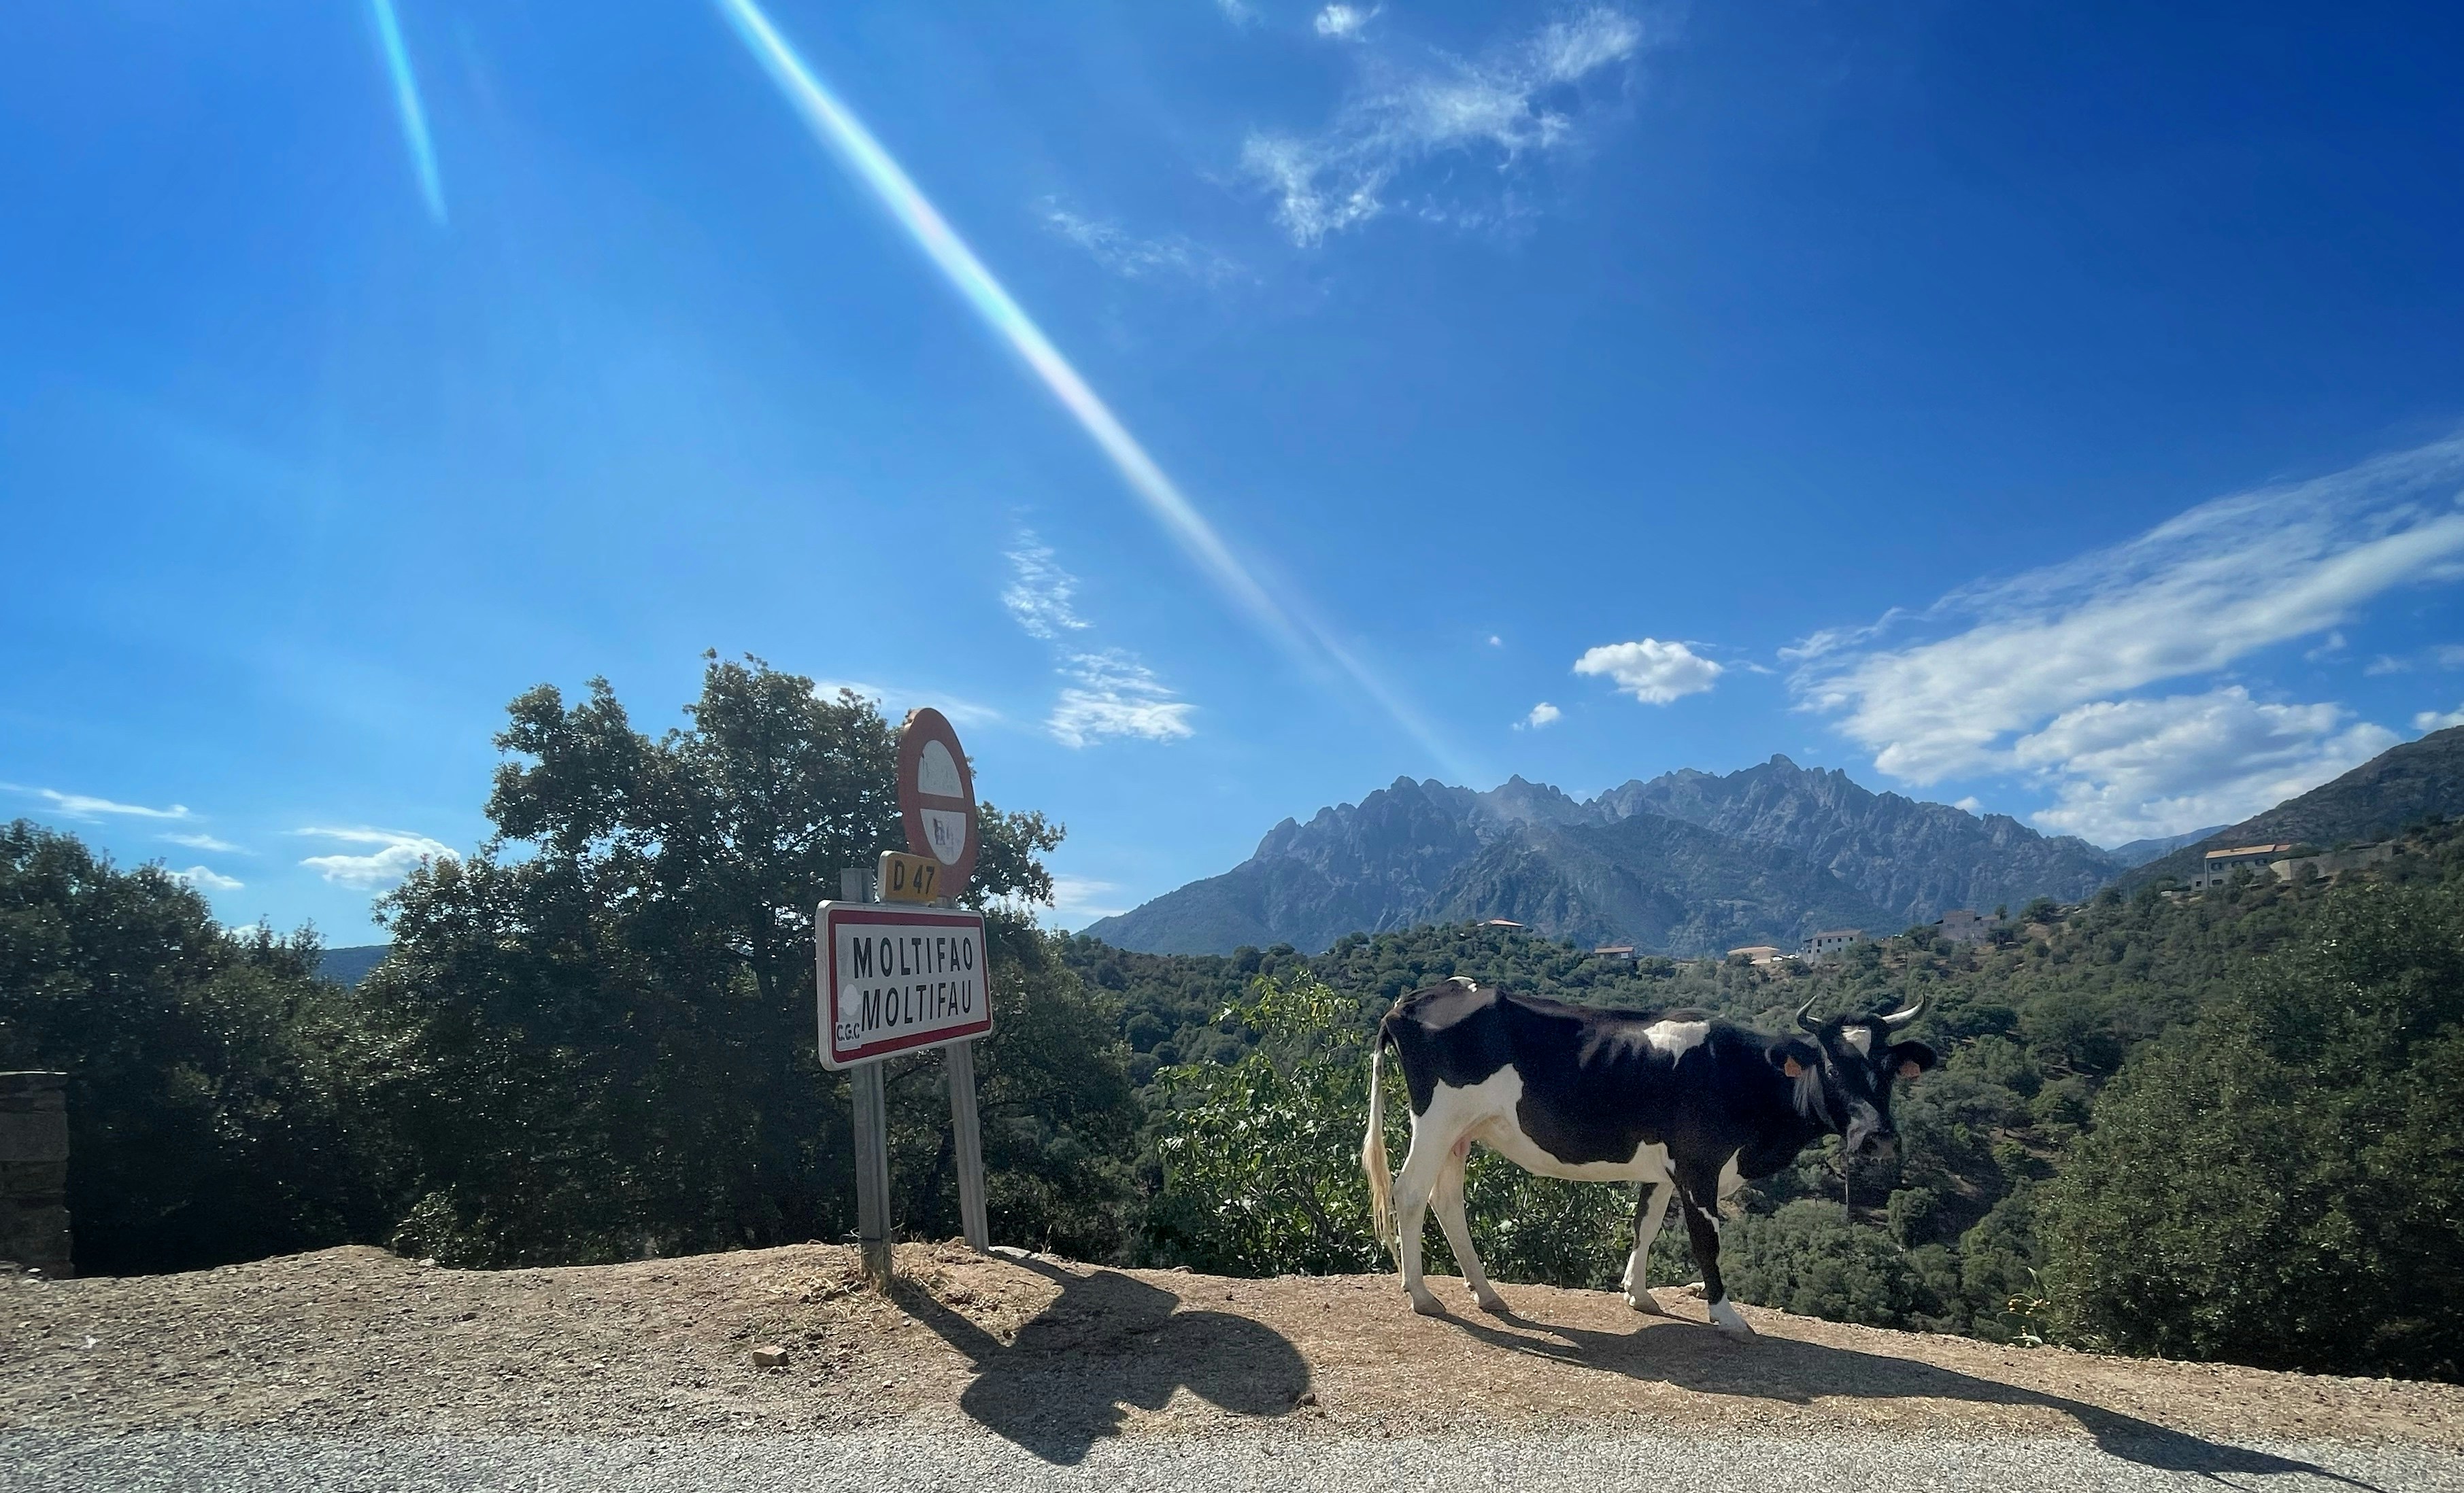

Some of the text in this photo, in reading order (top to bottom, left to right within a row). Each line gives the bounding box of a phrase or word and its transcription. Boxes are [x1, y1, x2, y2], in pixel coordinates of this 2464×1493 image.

[894, 860, 935, 895] D 47
[853, 937, 973, 979] MOLTIFAO
[861, 980, 971, 1032] MOLTIFAU
